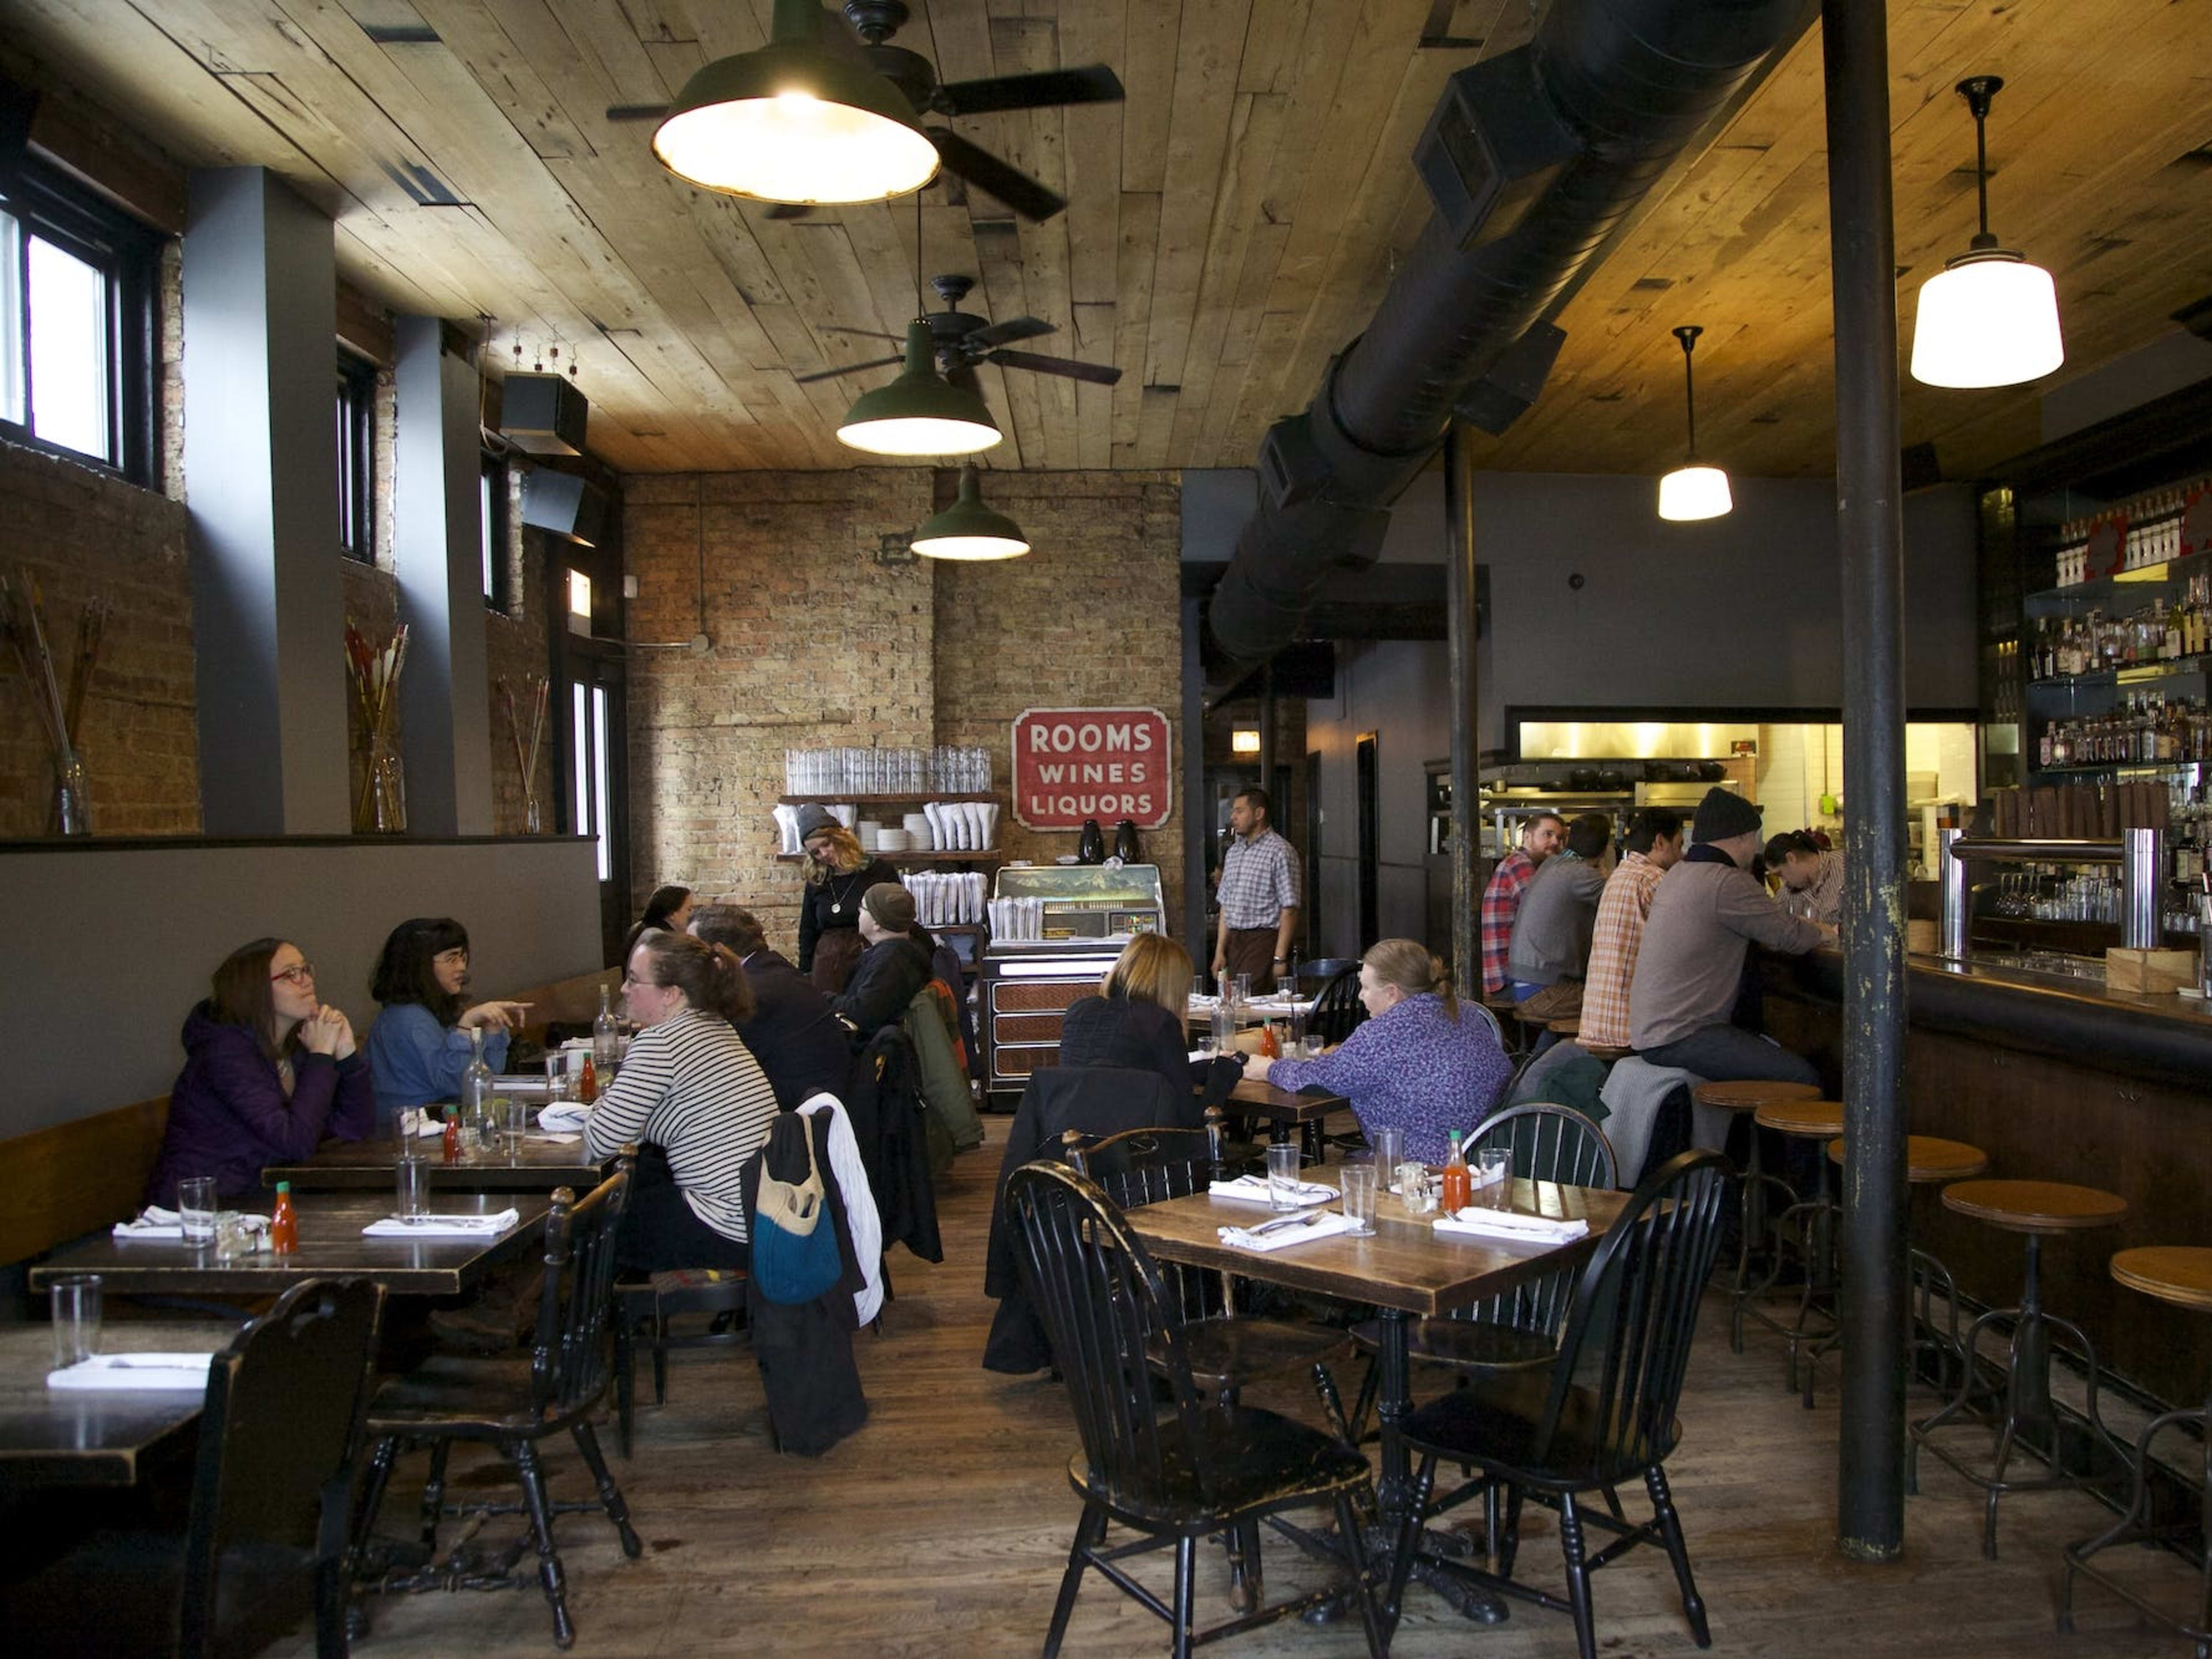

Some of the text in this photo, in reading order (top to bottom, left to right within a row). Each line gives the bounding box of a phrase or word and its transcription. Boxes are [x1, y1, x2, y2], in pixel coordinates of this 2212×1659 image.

[1031, 724, 1152, 752] ROOMS
[1039, 763, 1146, 784] WINES
[1032, 794, 1152, 816] LIQUORS
